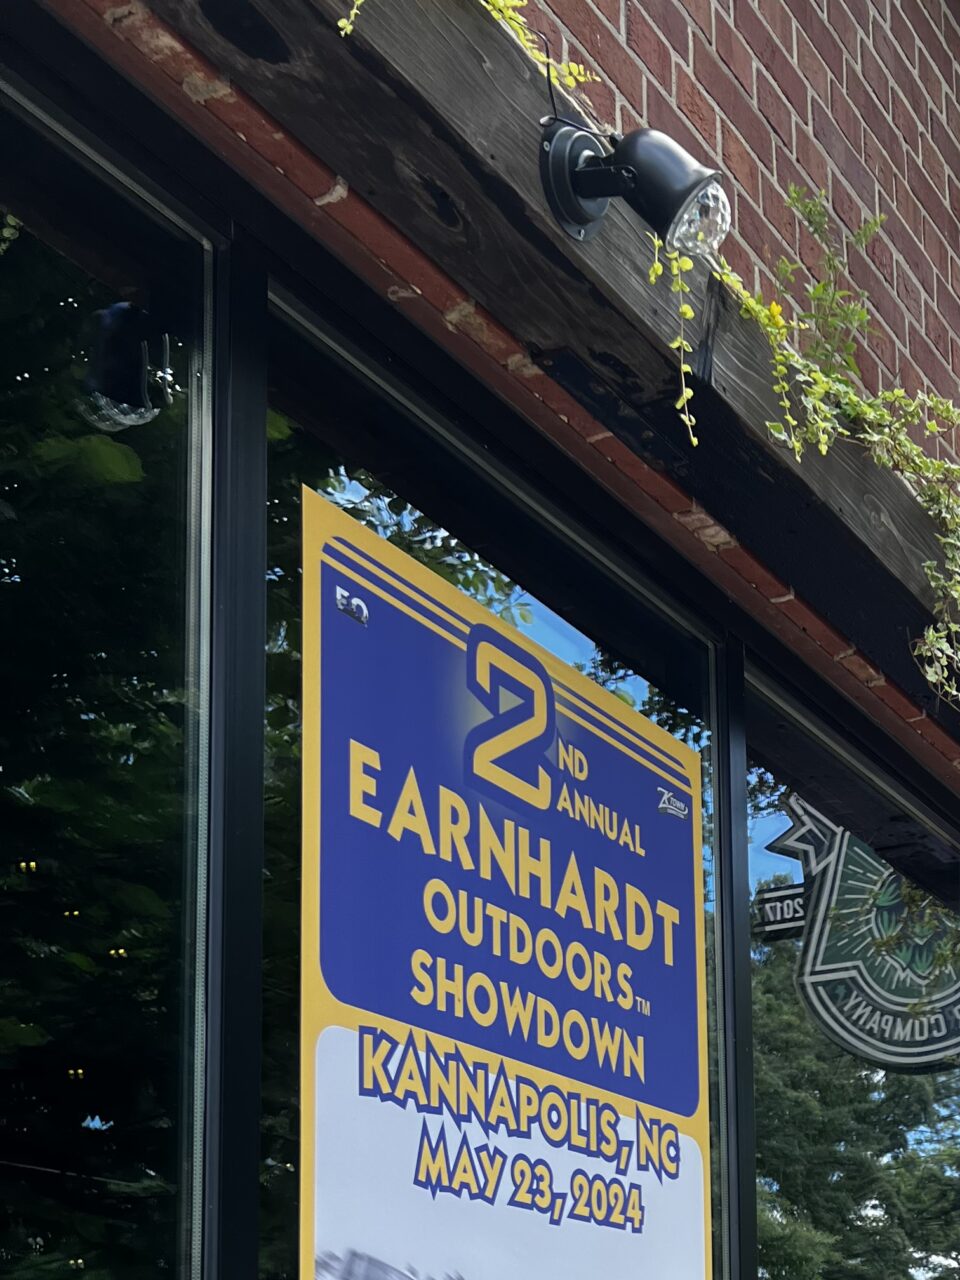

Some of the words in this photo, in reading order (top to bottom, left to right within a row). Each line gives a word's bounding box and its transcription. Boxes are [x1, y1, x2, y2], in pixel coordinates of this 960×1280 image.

[473, 640, 552, 811] 2
[557, 738, 589, 782] ND
[349, 738, 680, 967] EARNHARDT
[556, 782, 646, 858] ANNUAL
[423, 878, 633, 1010] OUTDOORS
[410, 949, 646, 1085] SHOWDOWN
[358, 1025, 633, 1176] KANNAPOLIS,
[635, 1102, 681, 1185] NC
[413, 1116, 508, 1206] MAY
[508, 1153, 567, 1226] 23,
[567, 1168, 645, 1234] 2024
